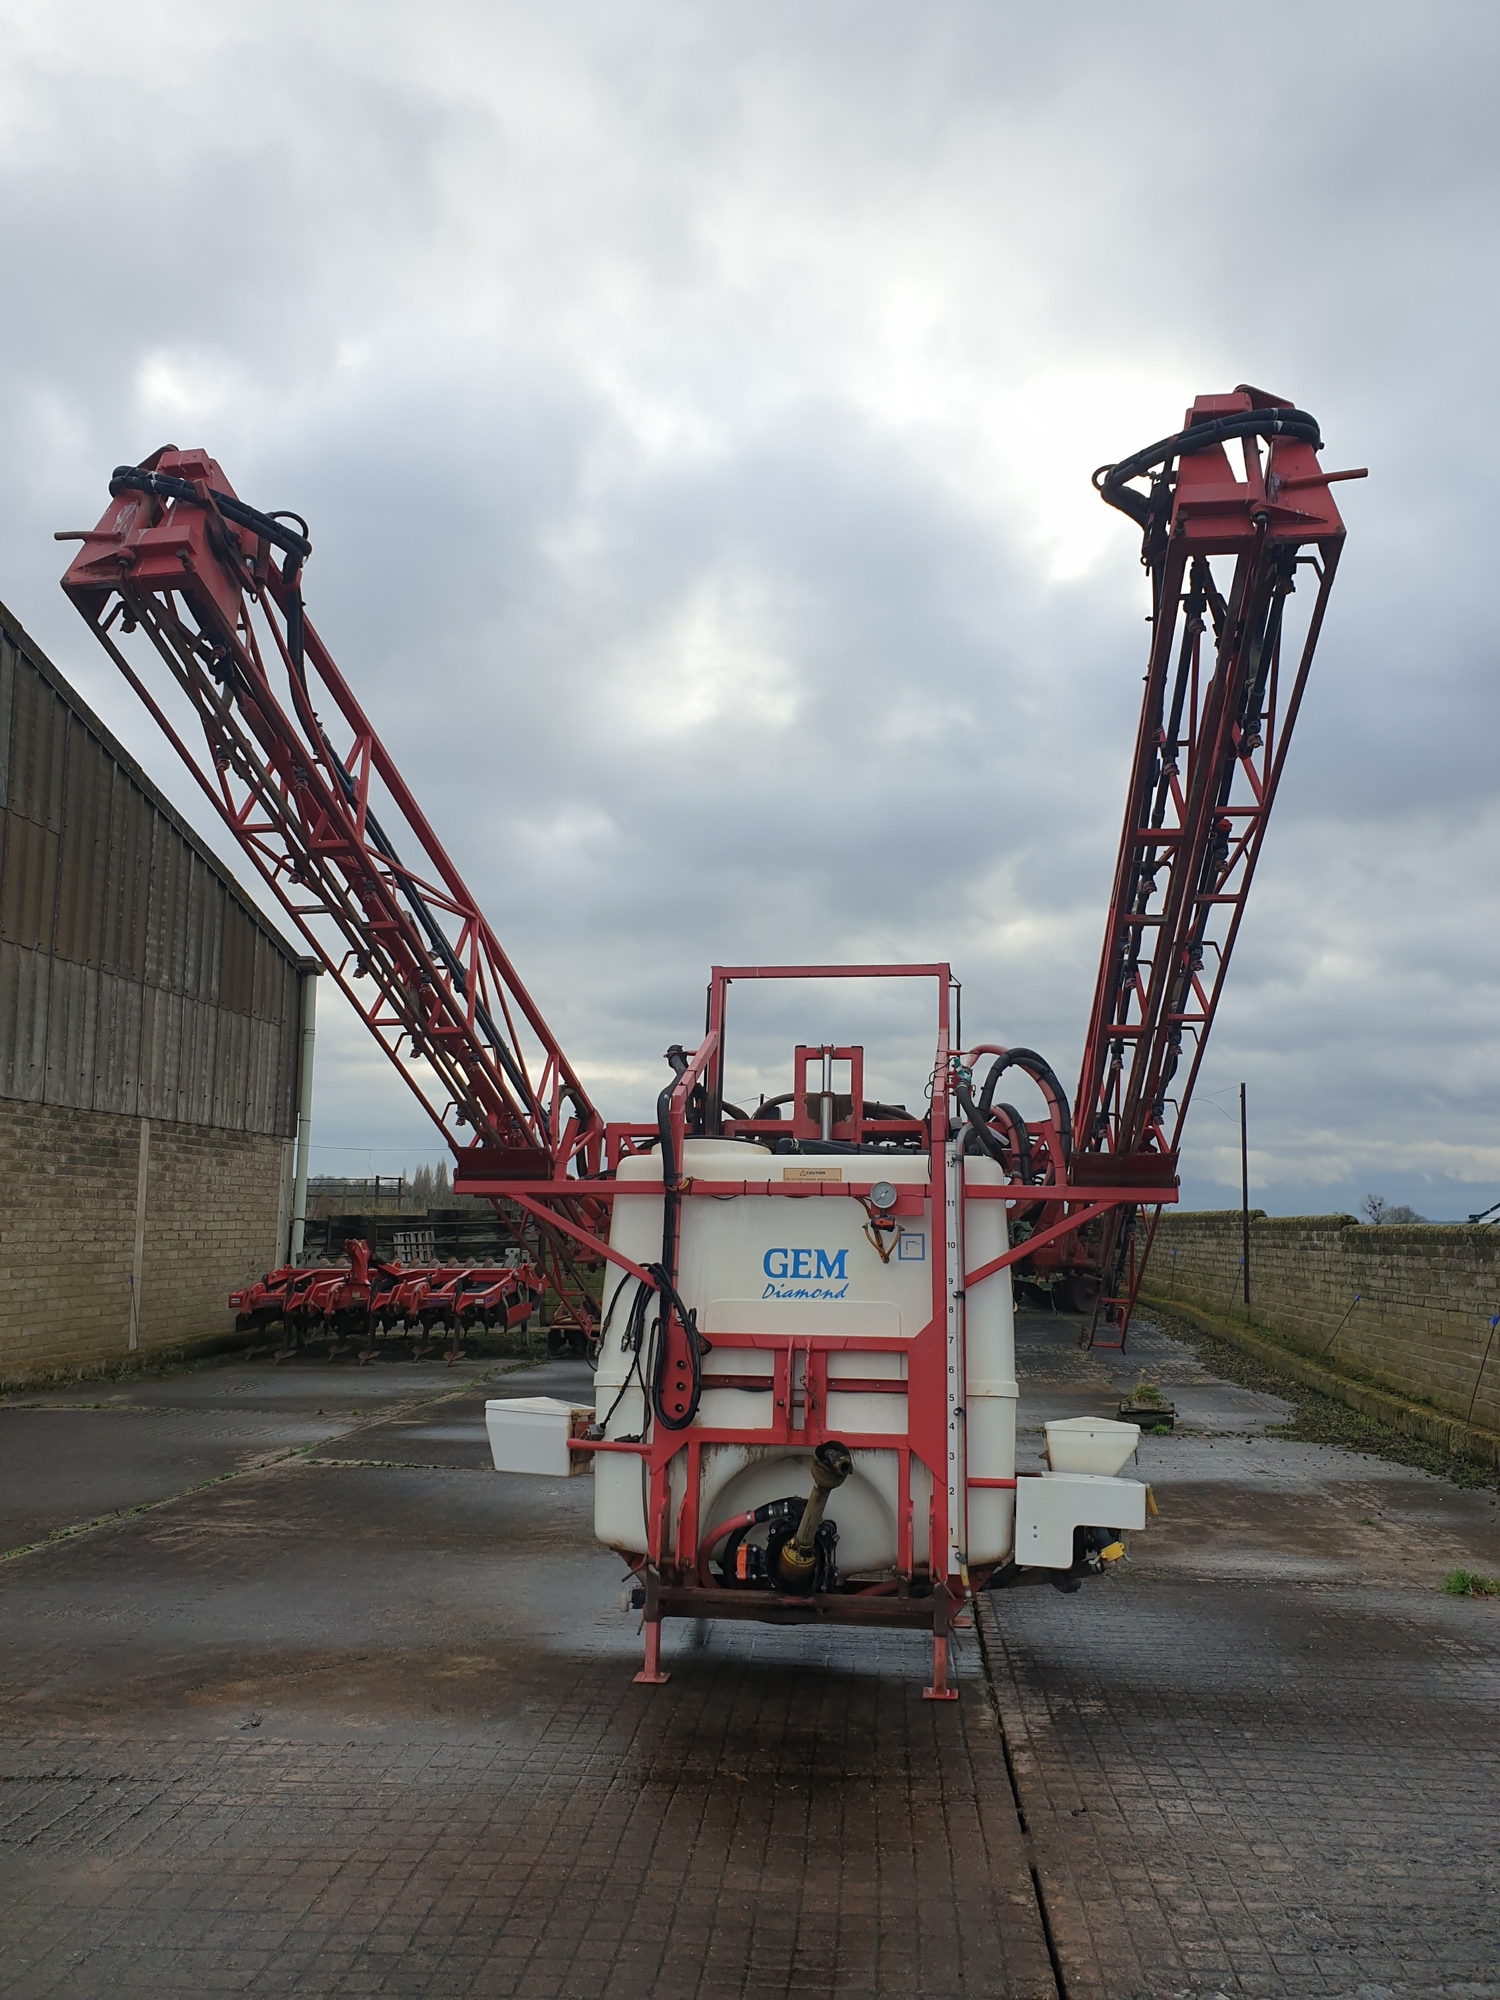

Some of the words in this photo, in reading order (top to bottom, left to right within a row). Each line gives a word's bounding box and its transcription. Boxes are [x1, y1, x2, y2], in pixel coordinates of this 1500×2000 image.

[946, 1160, 955, 1168] 12
[947, 1241, 955, 1249] 10
[763, 1248, 849, 1279] GEM
[948, 1277, 954, 1285] 9
[762, 1283, 849, 1299] Diamond
[948, 1306, 954, 1314] 8
[948, 1336, 954, 1344] 7
[949, 1366, 954, 1374] 6
[949, 1394, 954, 1402] 5
[949, 1452, 955, 1460] 3
[949, 1487, 955, 1495] 2
[949, 1527, 954, 1535] 1
